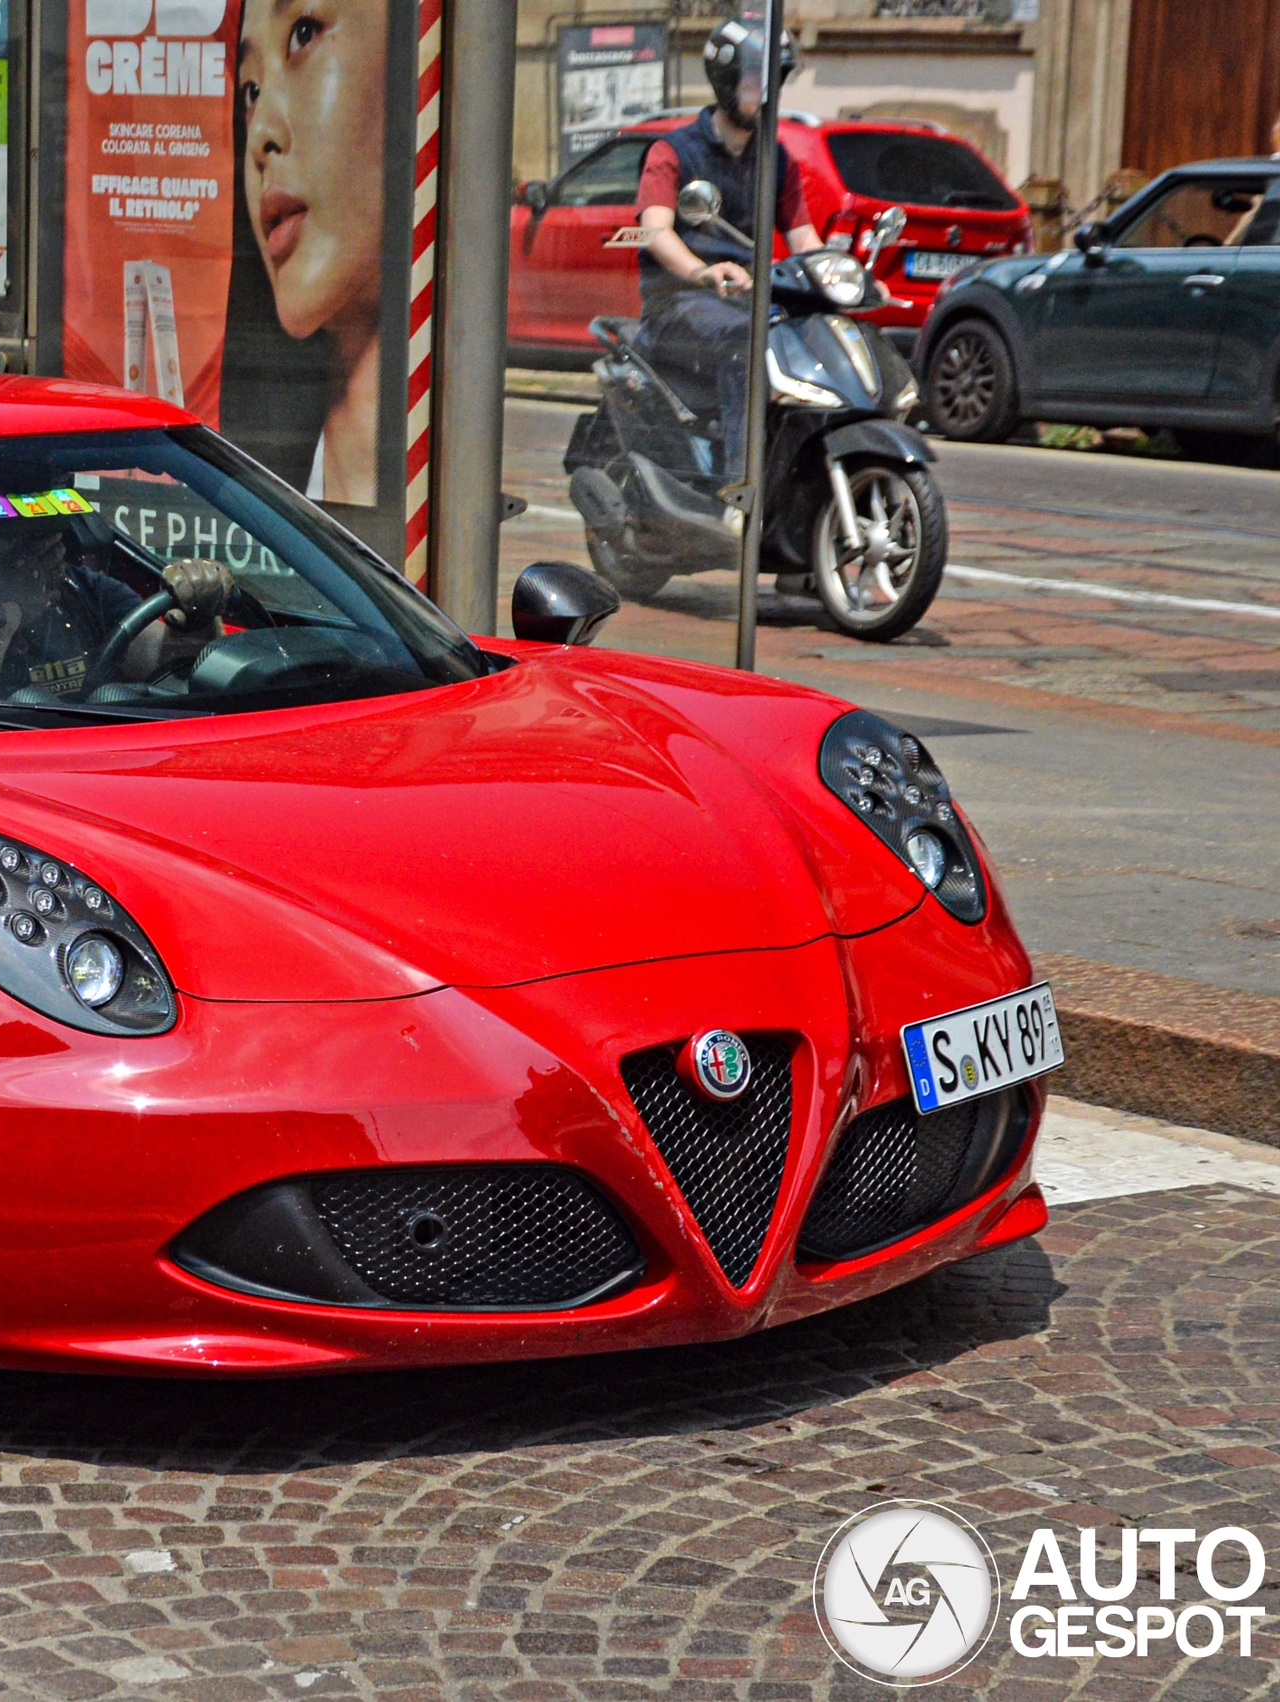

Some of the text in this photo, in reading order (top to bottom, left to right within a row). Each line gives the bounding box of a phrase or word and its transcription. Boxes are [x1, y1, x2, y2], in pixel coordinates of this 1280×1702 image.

[85, 36, 226, 95] CRÈME
[109, 122, 202, 139] SKINCARE COREANA
[101, 139, 210, 157] COLORATA AL GINSENG
[92, 174, 219, 199] EFFICACE QUANTO
[109, 197, 123, 216] IL
[25, 502, 47, 514] 21
[114, 505, 295, 576] SEPHOR
[701, 1035, 747, 1067] ALFA ROMEO
[920, 1078, 931, 1096] D
[932, 1030, 959, 1093] S
